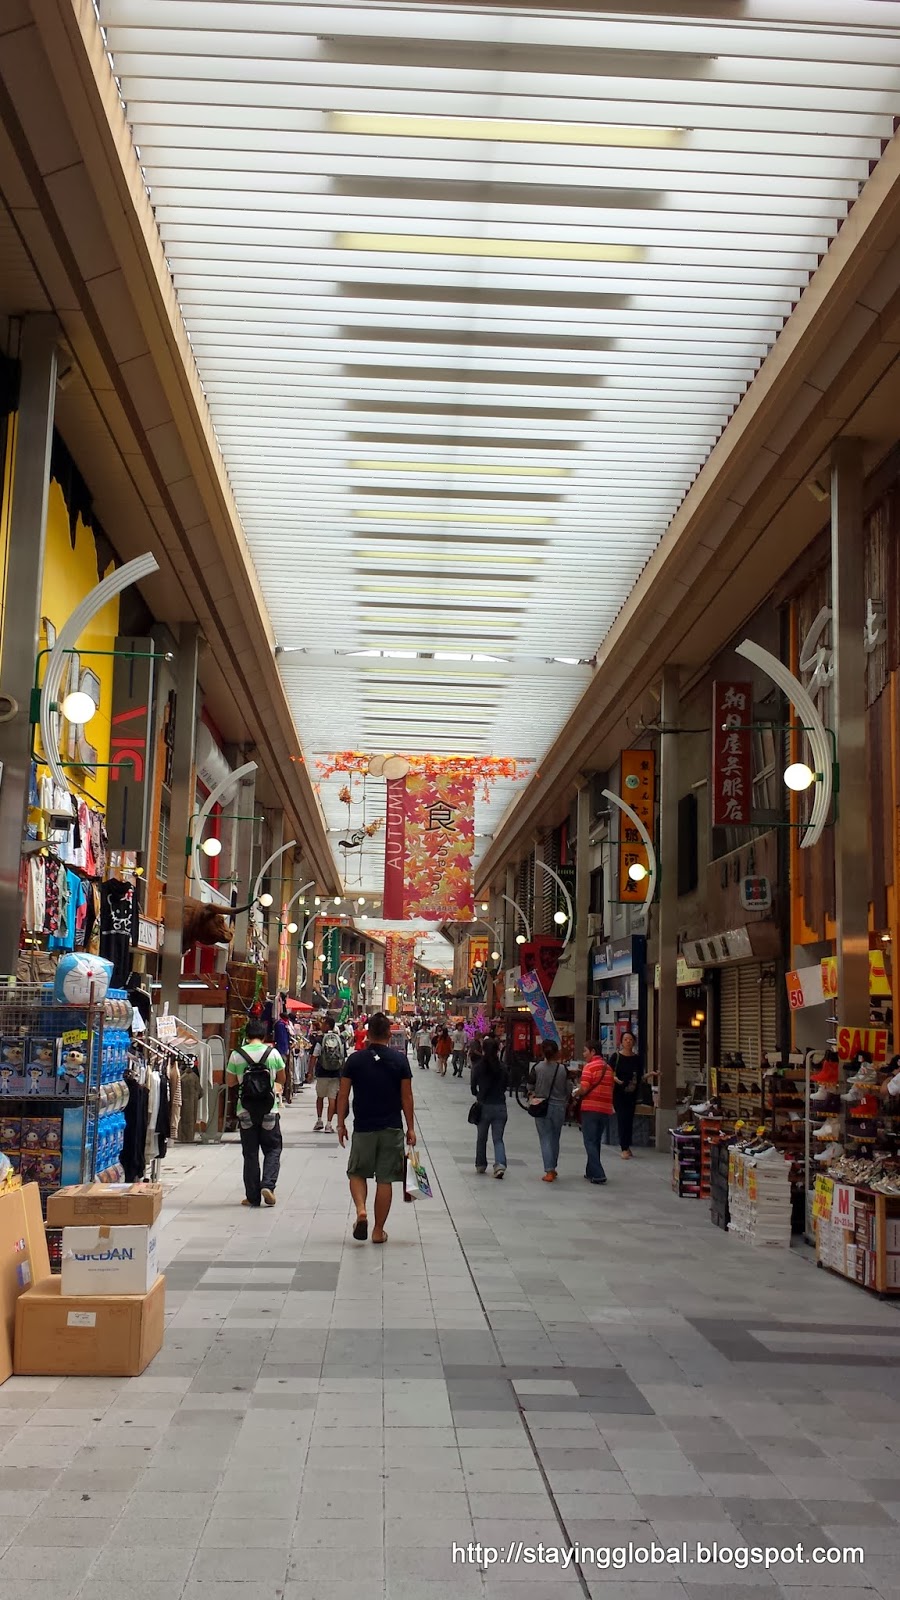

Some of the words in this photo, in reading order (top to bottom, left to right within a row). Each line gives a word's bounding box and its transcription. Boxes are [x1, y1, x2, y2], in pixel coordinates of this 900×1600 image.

[110, 705, 148, 782] VIC
[387, 778, 405, 870] AUTUMN
[790, 989, 804, 1007] 50
[838, 1028, 888, 1062] SALE
[838, 1188, 850, 1216] M
